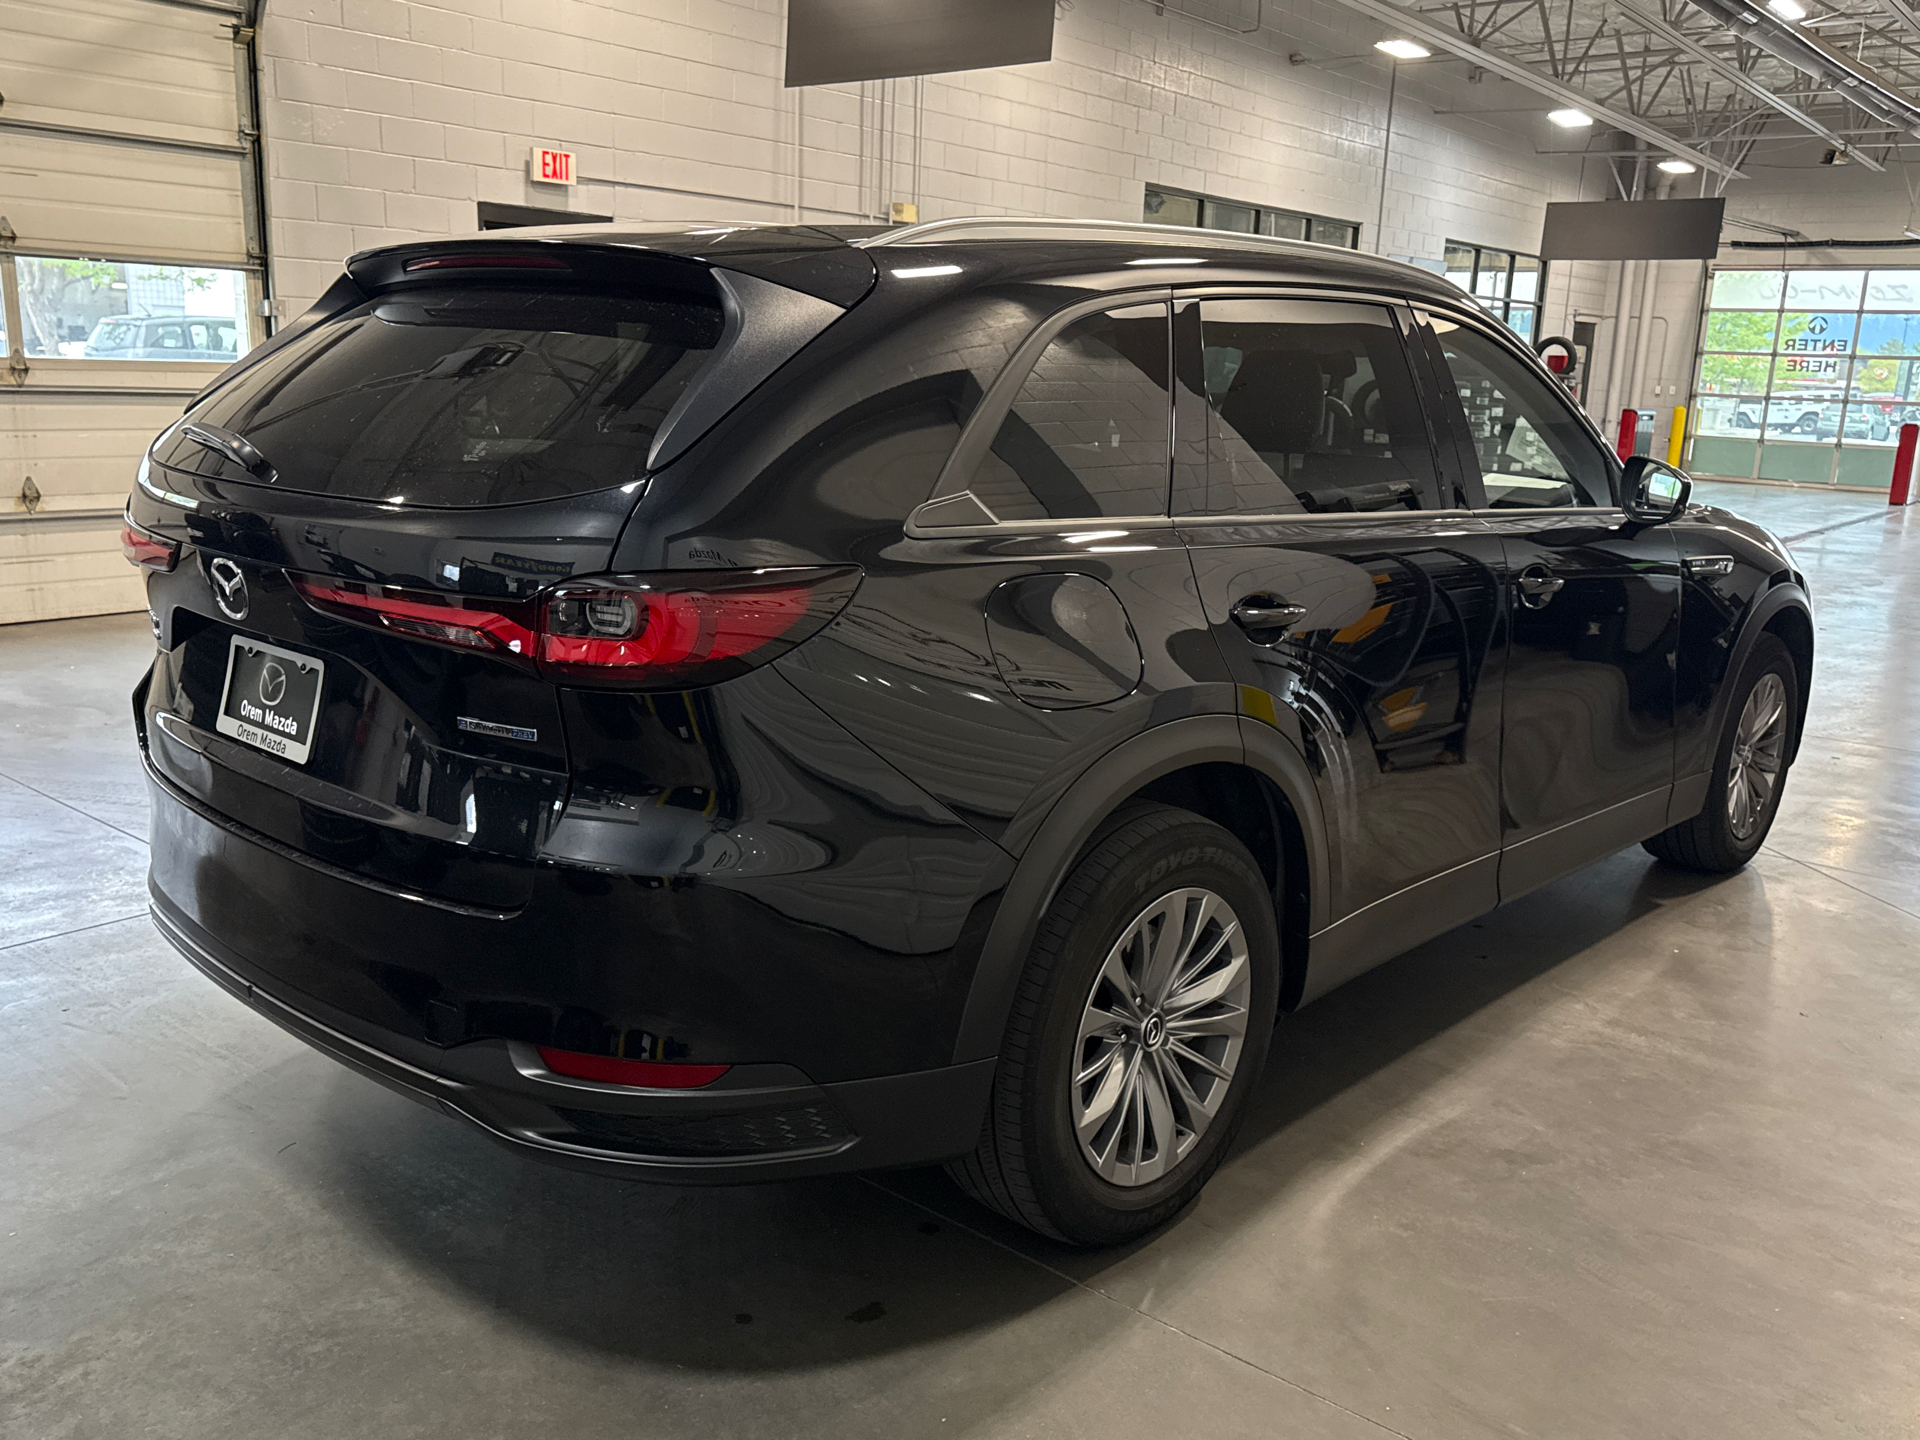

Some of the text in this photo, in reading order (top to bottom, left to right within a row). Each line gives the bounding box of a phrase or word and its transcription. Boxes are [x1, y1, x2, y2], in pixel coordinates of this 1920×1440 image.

[542, 150, 571, 181] EXIT
[240, 699, 298, 736] Orem Mazda
[236, 723, 287, 754] Orem Mazda
[1135, 846, 1201, 894] TOYO
